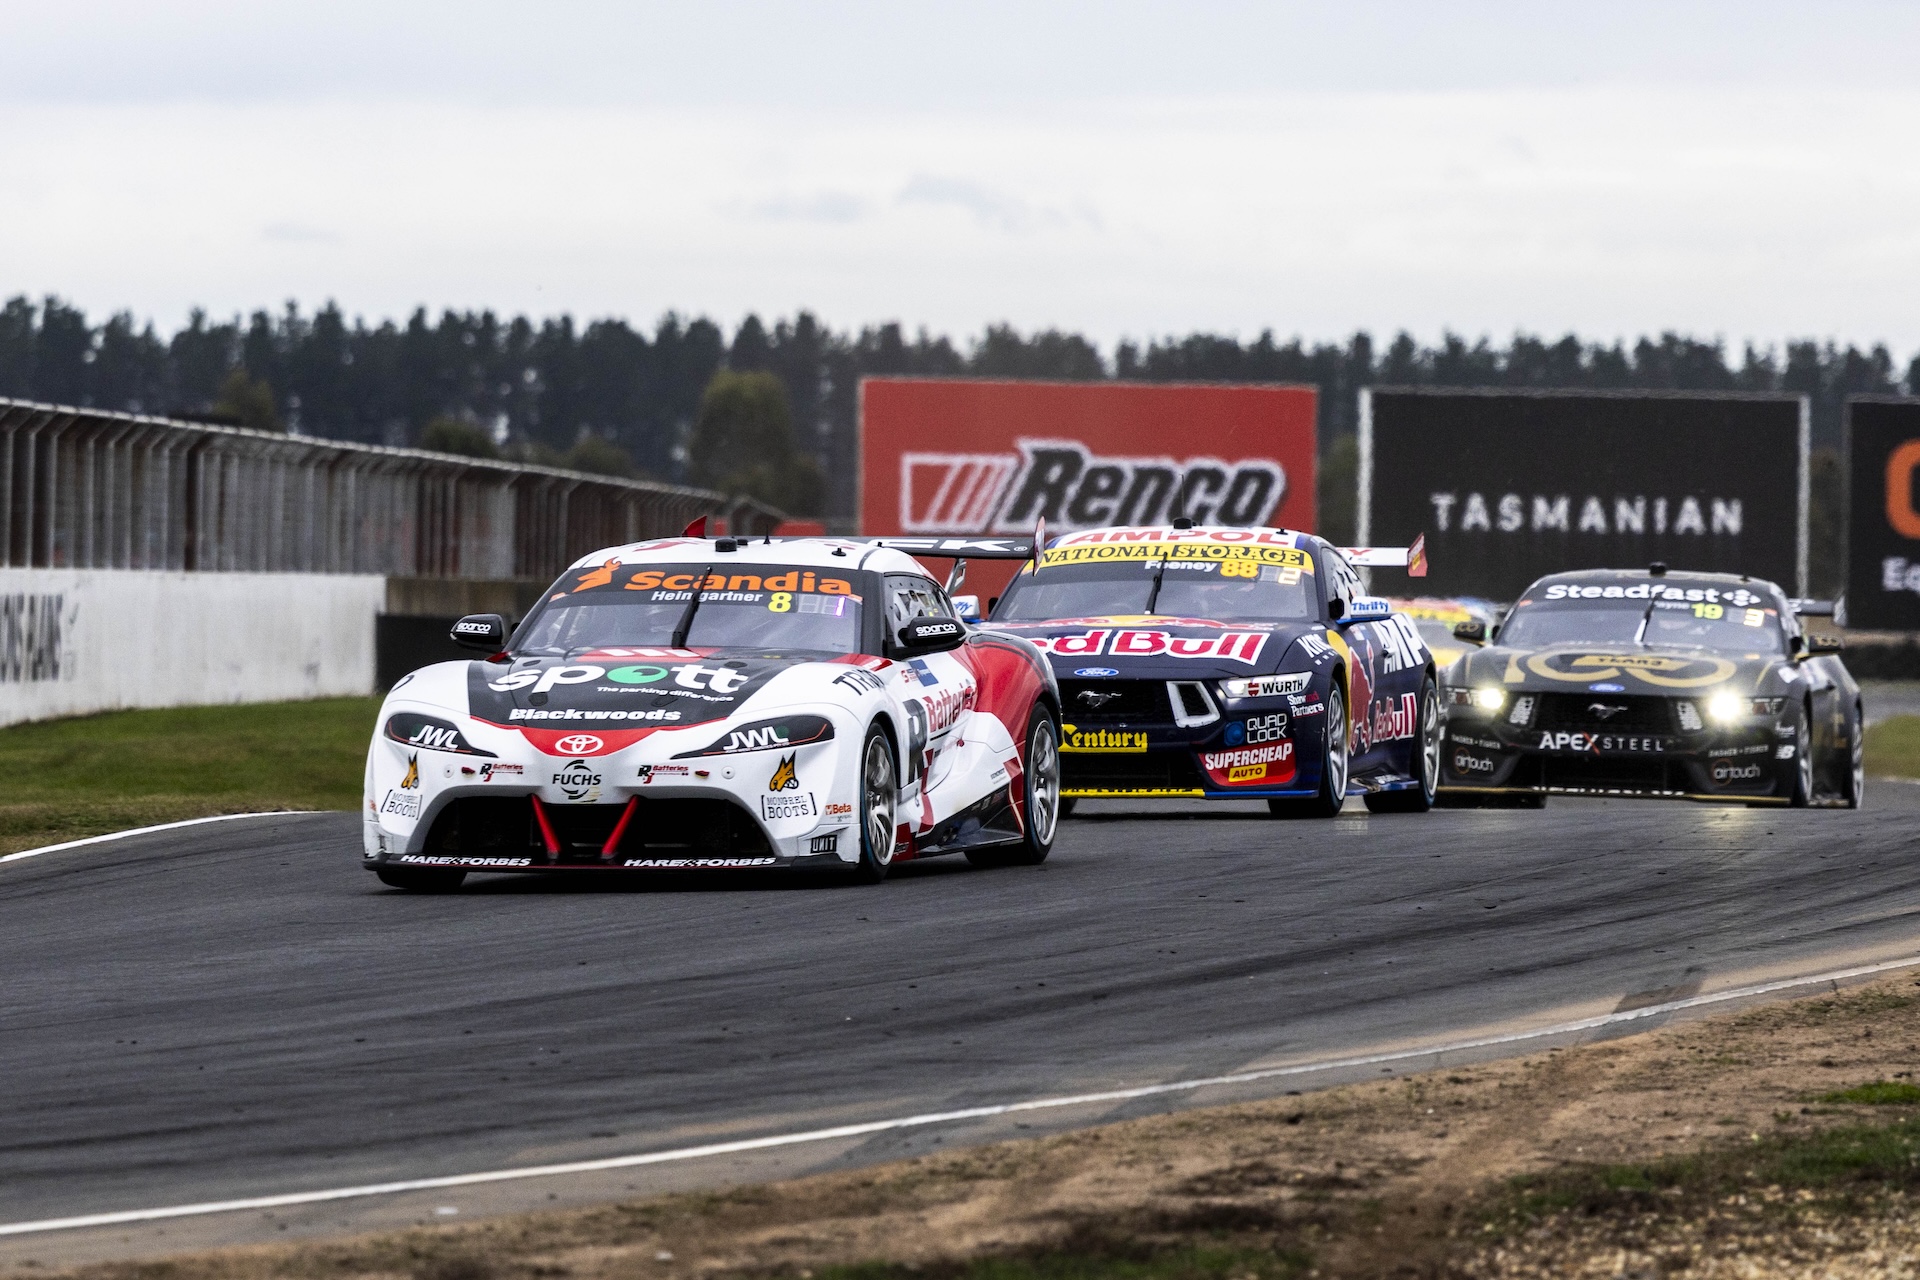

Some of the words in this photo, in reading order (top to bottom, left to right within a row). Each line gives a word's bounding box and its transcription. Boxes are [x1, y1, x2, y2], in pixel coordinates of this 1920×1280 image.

[995, 438, 1287, 532] Renco
[1430, 493, 1743, 535] TASMANIAN
[1067, 530, 1290, 546] AMPOL
[1042, 545, 1165, 563] NATIONAL
[1176, 545, 1302, 564] STORAGE
[1145, 561, 1217, 572] Feeney
[1220, 561, 1259, 578] 88
[1278, 566, 1301, 585] 2
[624, 571, 852, 594] Scandia
[1545, 584, 1720, 603] Steadfast
[768, 592, 792, 613] 8
[1352, 601, 1389, 612] Thrifty
[1691, 603, 1723, 620] 19
[1743, 608, 1764, 627] 3
[456, 622, 491, 633] sparco
[915, 623, 957, 635] sparco
[1111, 631, 1269, 664] Bull
[488, 664, 748, 693] spott
[1262, 679, 1303, 694] WÜRTH
[619, 687, 669, 696] parking
[669, 689, 734, 702] difference
[509, 709, 681, 721] Blackwoods
[1291, 702, 1325, 718] Partners
[1247, 713, 1287, 730] QUAD
[409, 725, 458, 749] JWL
[723, 726, 789, 750] JWL
[1060, 724, 1148, 748] Century
[1247, 726, 1286, 743] LOCK
[1539, 732, 1600, 754] APEX
[1602, 737, 1664, 752] STEEL
[1205, 743, 1293, 770] SUPERCHEAP
[552, 774, 601, 786] FUCHS
[1232, 767, 1263, 779] AUTO
[768, 804, 809, 819] BOOTS
[832, 804, 852, 815] Beta
[812, 836, 836, 852] UNIT
